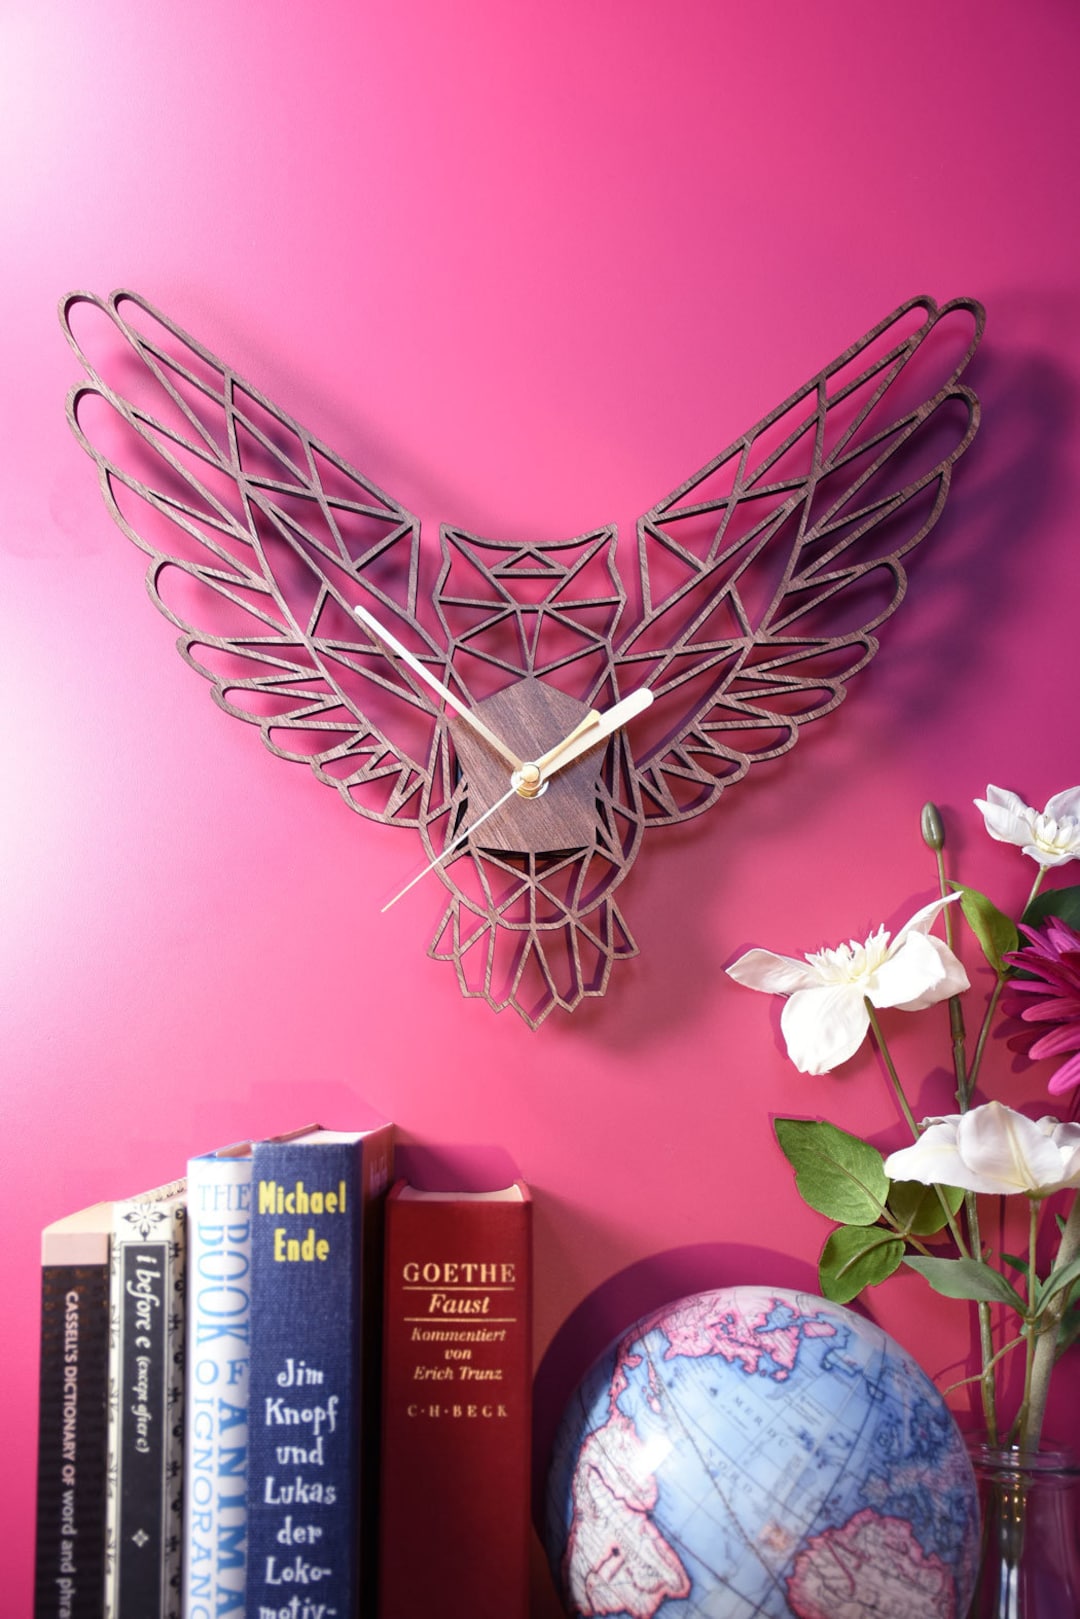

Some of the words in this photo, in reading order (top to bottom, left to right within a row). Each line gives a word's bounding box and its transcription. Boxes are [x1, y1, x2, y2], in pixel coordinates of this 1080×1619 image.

[198, 1183, 250, 1212] THE
[258, 1180, 346, 1215] Michael
[136, 1254, 157, 1264] i
[274, 1228, 330, 1262] Ende
[197, 1219, 250, 1346] BOOK
[402, 1262, 516, 1283] GOETHE
[126, 1269, 161, 1331] before
[428, 1293, 491, 1314] Faust
[64, 1291, 79, 1363] CASSELL'S
[410, 1327, 507, 1342] Kommentiert
[135, 1336, 151, 1349] e
[444, 1349, 472, 1361] von
[132, 1356, 151, 1401] (except
[276, 1358, 324, 1387] Jim
[413, 1366, 454, 1380] Erich
[458, 1366, 503, 1381] Trunz
[62, 1366, 78, 1461] DICTIONARY
[265, 1395, 339, 1436] Knopf
[275, 1436, 324, 1466] und
[61, 1464, 76, 1486] OF
[264, 1476, 337, 1504] Lukas
[61, 1490, 78, 1535] word
[277, 1516, 323, 1546] der
[60, 1540, 77, 1574] and
[265, 1556, 332, 1585] Loko-
